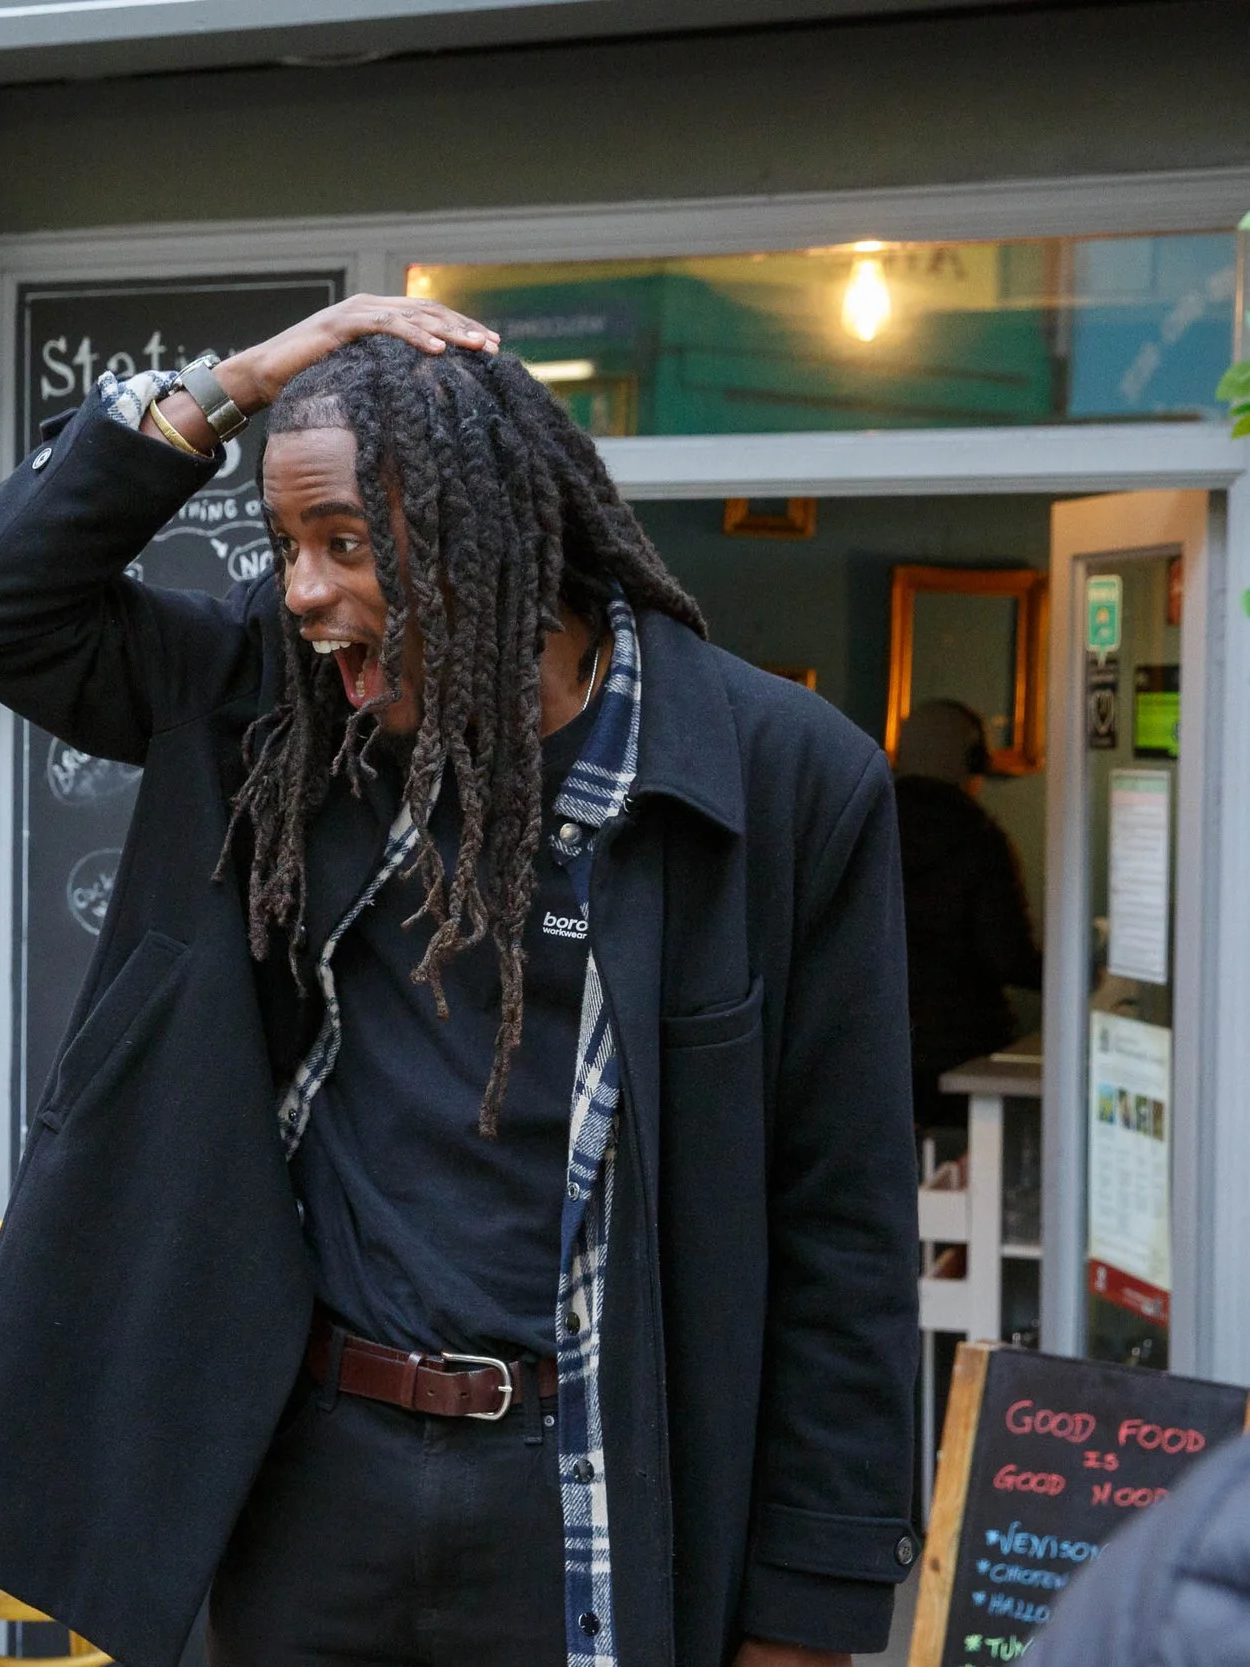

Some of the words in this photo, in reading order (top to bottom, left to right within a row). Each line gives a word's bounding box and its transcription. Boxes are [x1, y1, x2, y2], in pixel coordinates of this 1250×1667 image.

[41, 331, 245, 400] Stati
[542, 926, 588, 940] workwear
[543, 911, 589, 932] boro
[1005, 1400, 1097, 1444] GOOD
[1117, 1418, 1206, 1454] FOOD
[993, 1464, 1067, 1497] GOOD
